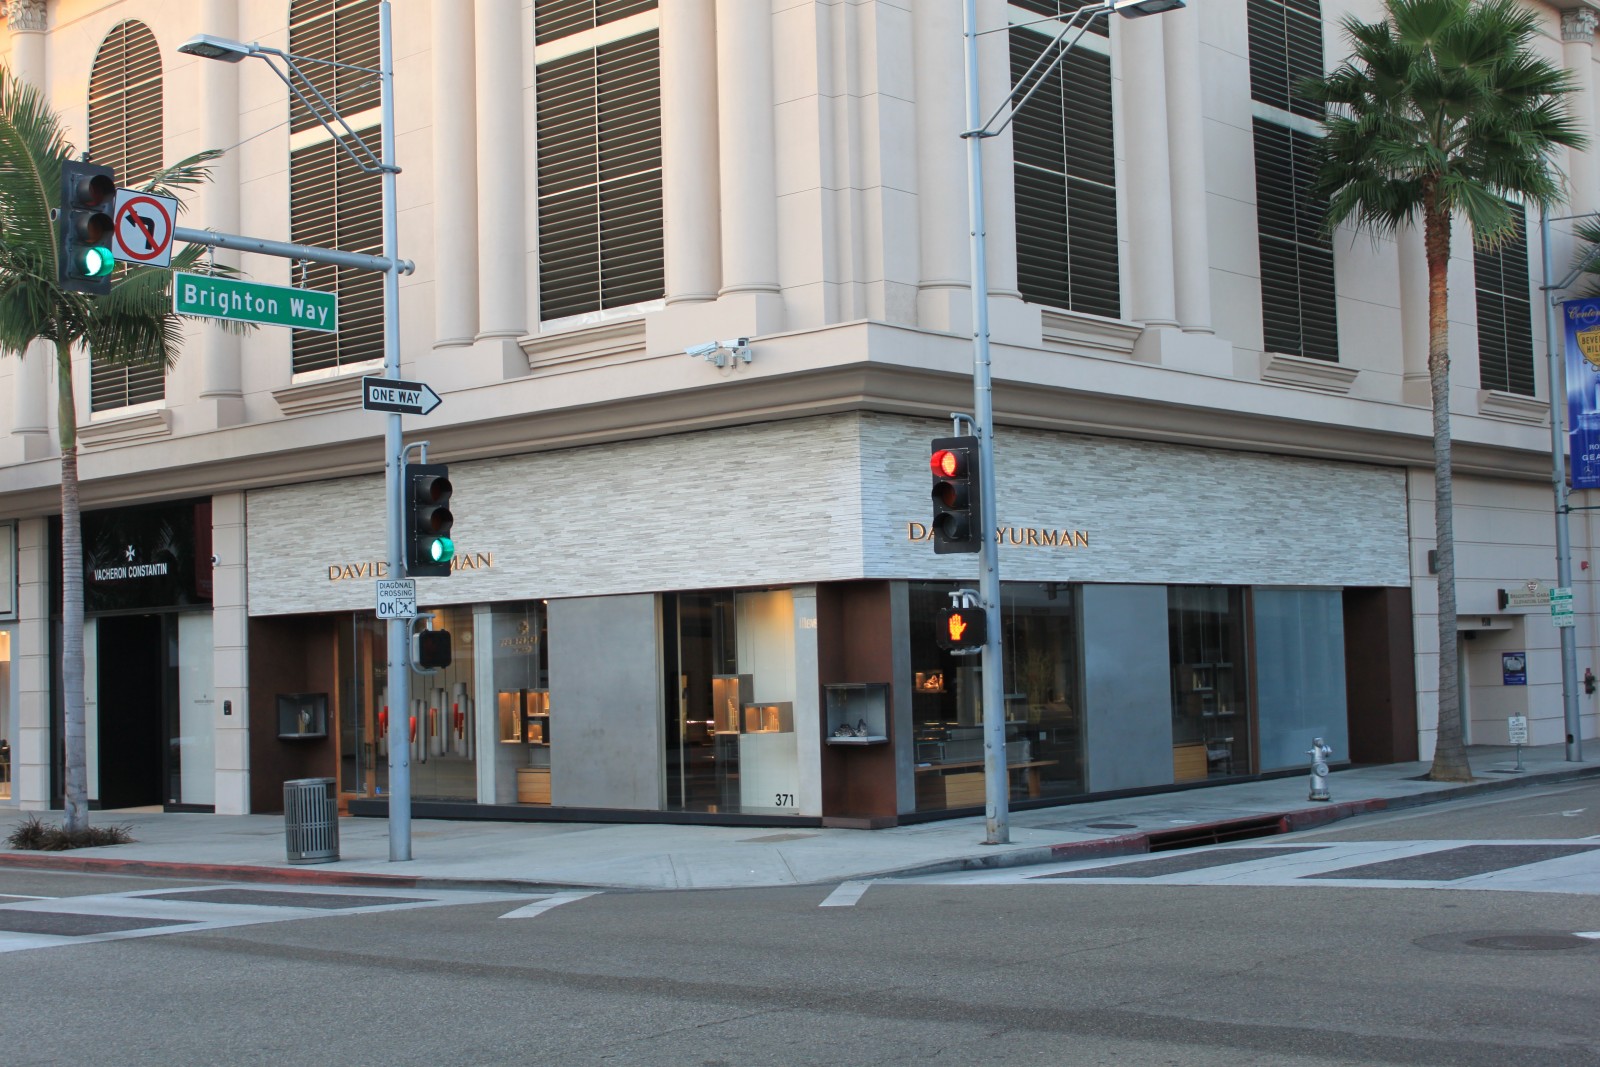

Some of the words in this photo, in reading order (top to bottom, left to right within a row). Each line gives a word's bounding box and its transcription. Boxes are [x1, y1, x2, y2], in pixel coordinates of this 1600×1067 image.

[184, 283, 278, 315] Brighton
[290, 297, 328, 326] Way
[1581, 335, 1600, 345] BEVE
[372, 388, 395, 402] ONE
[398, 391, 420, 405] WAY
[996, 526, 1089, 548] YURMAN
[94, 566, 127, 581] VACHERON
[128, 562, 168, 578] CONSTANTIN
[379, 581, 413, 590] DIAGONAL
[379, 589, 413, 597] CROSSING
[379, 602, 395, 615] OK
[775, 793, 794, 806] 371
